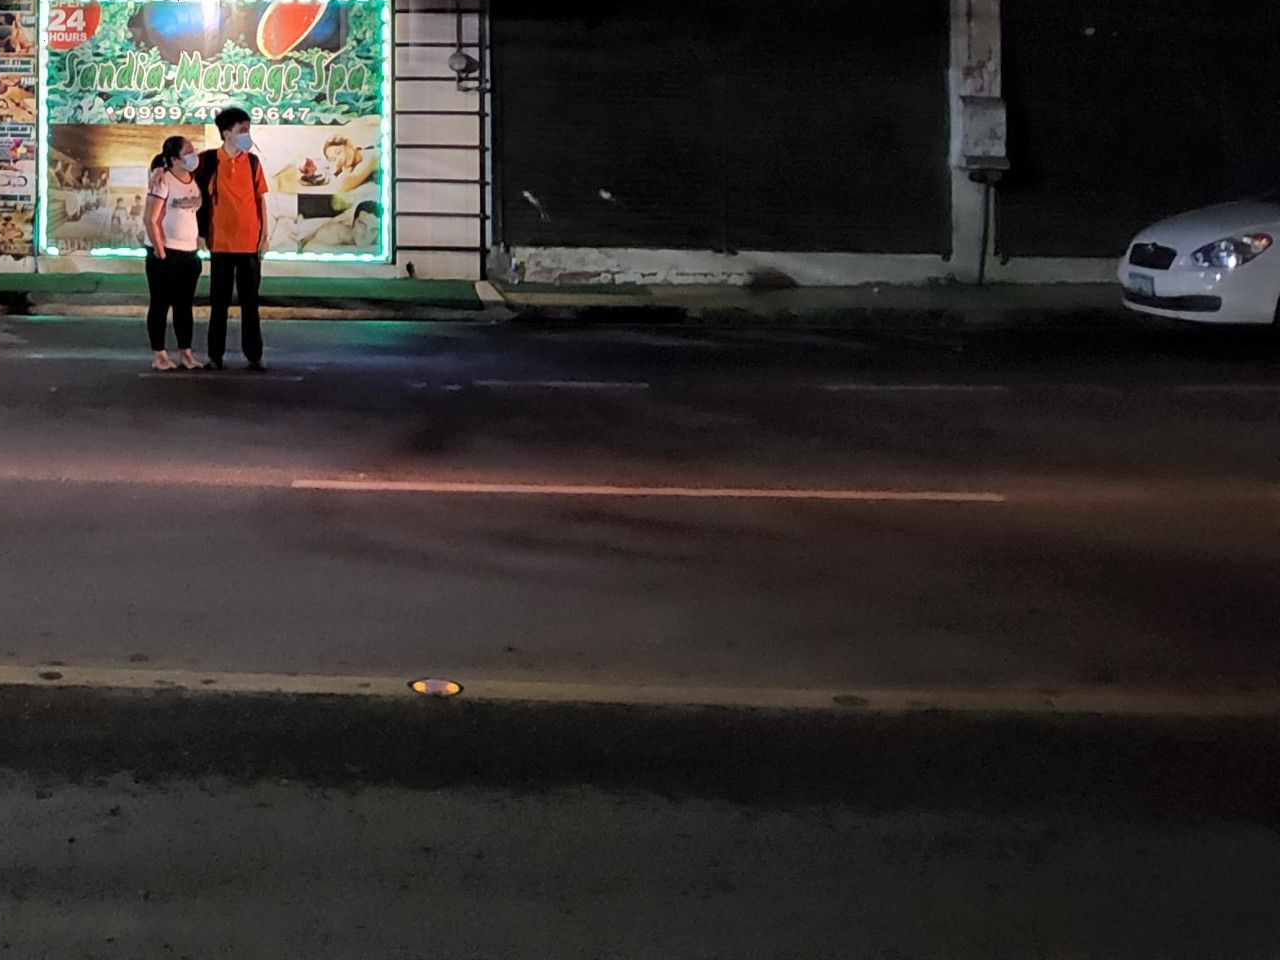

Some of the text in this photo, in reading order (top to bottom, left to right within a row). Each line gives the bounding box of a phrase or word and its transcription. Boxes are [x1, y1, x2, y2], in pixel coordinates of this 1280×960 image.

[48, 9, 86, 31] 24
[49, 32, 87, 42] HOURS
[64, 49, 369, 106] Sandia Massage Spa
[123, 106, 311, 121] 0999-409647
